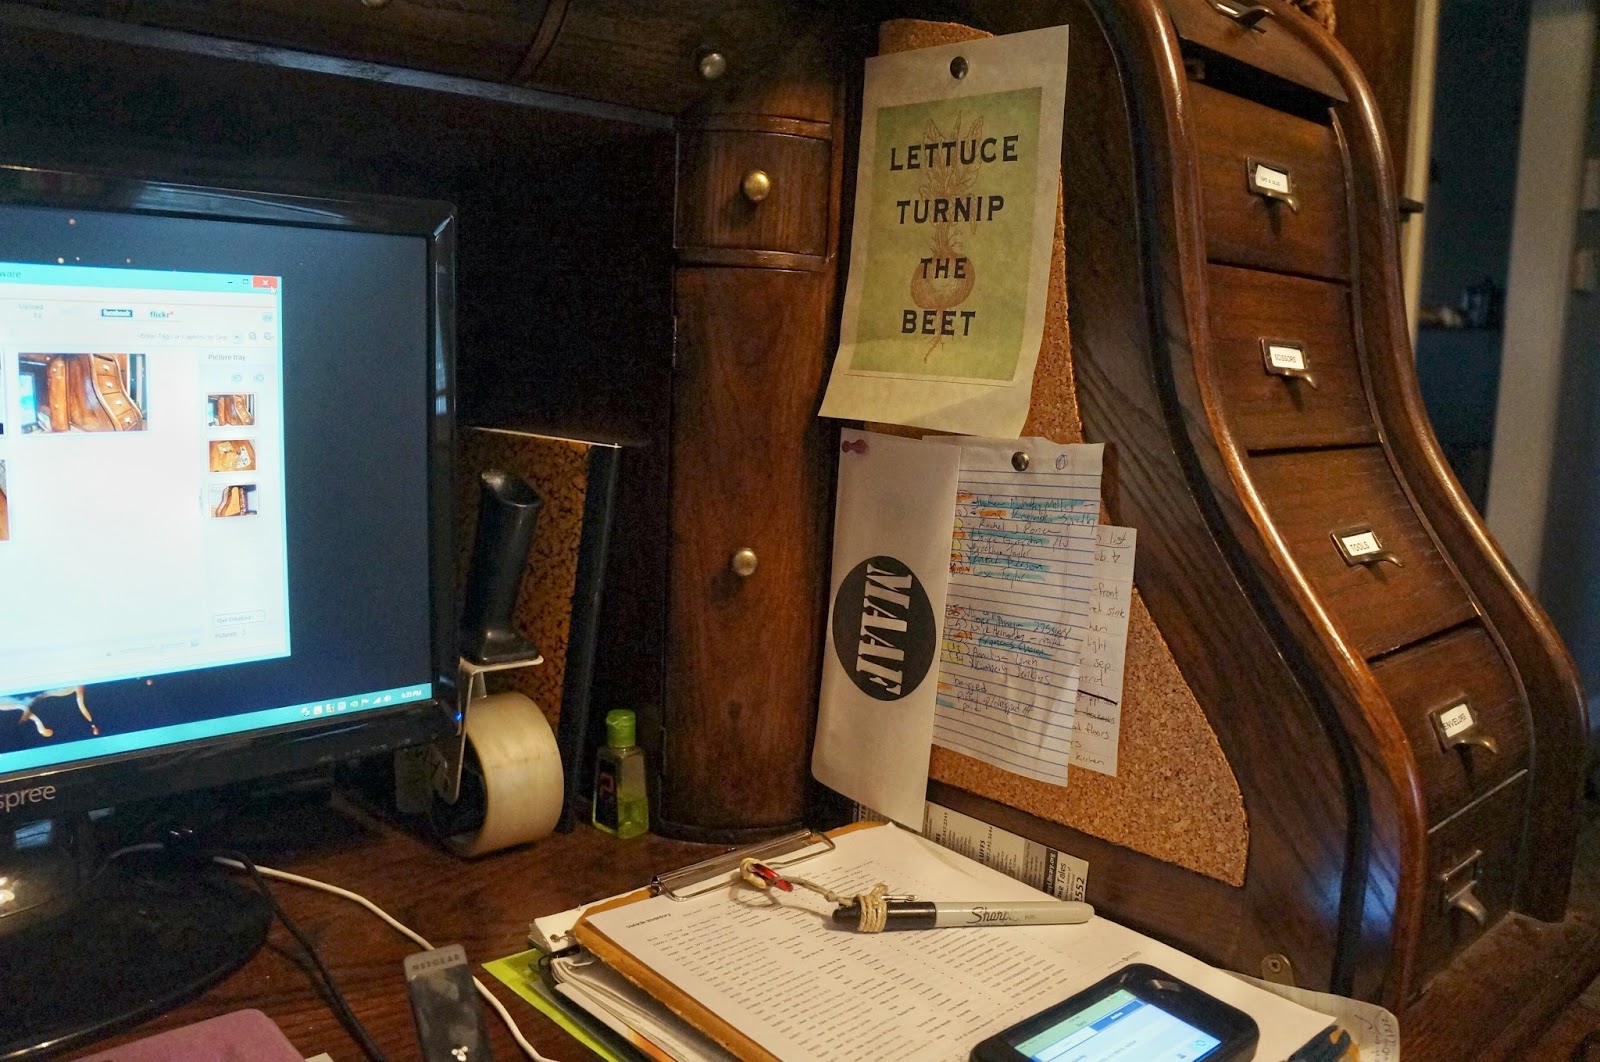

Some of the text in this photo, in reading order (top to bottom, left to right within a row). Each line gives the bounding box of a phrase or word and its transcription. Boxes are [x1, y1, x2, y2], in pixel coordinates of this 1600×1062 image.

[890, 135, 1019, 171] LETTUCE
[896, 195, 1005, 225] TURNIP
[920, 257, 967, 279] THE
[150, 311, 171, 319] flickr
[901, 309, 976, 336] BEET
[1350, 541, 1371, 552] TOOLS
[856, 563, 913, 696] MAAF
[1057, 862, 1067, 884] Tales
[412, 953, 460, 970] NETGEAR
